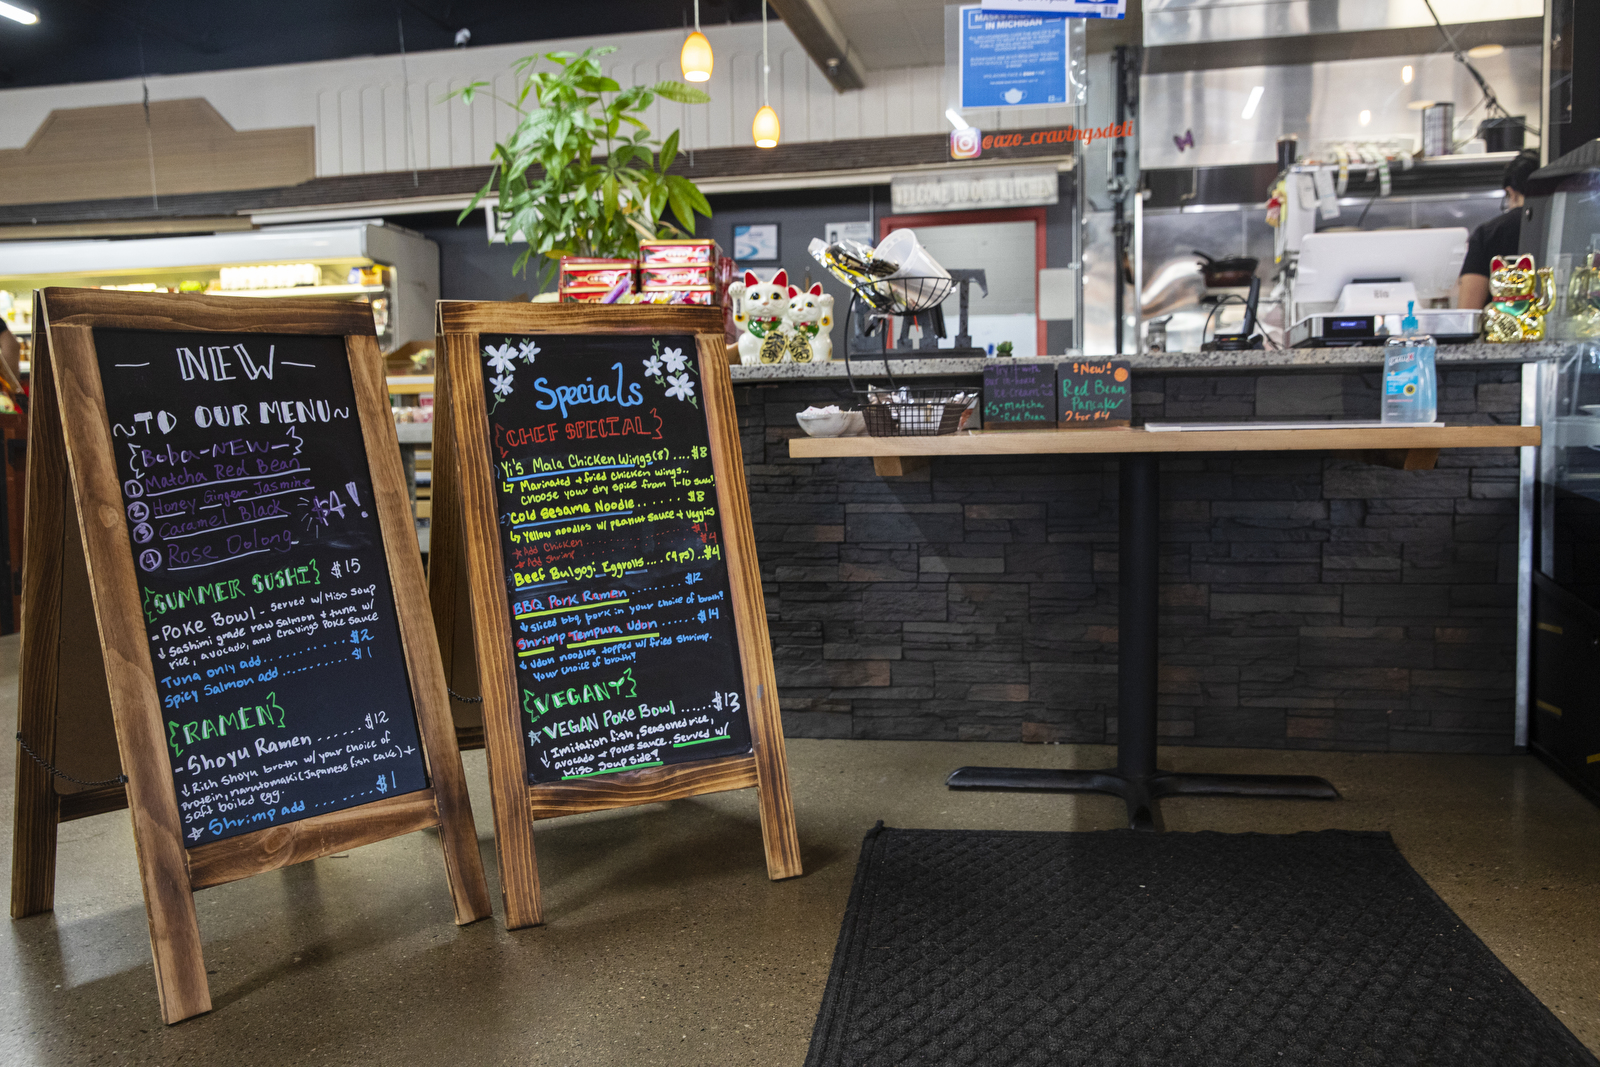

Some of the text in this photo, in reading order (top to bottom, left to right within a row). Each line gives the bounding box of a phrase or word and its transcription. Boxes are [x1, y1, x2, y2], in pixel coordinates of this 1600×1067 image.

[985, 18, 1042, 30] IN MICHIGAN
[176, 344, 274, 381] NEW
[534, 362, 644, 418] Specials
[1063, 378, 1127, 398] Red Bean
[194, 404, 250, 428] OUR
[1004, 411, 1046, 422] Red Bean
[1065, 410, 1073, 422] 2
[1075, 412, 1092, 422] for
[1072, 396, 1124, 414] Pancake
[146, 458, 300, 493] Matcha Red Bean
[501, 458, 524, 478] Yi's
[532, 457, 564, 473] Mala
[568, 454, 616, 468] Chicken
[691, 446, 708, 460] $8
[153, 476, 310, 515] Honey Ginger Jasmine
[520, 476, 571, 492] Marinated
[584, 472, 607, 482] fried
[564, 488, 588, 500] your
[592, 484, 609, 494] dry
[612, 479, 638, 493] spice
[641, 479, 666, 490] from
[674, 478, 692, 488] 1-10
[159, 498, 292, 538] Caramel Black
[510, 508, 536, 524] Cold
[540, 502, 591, 520] Sesame
[595, 499, 634, 512] Noodle
[688, 490, 705, 502] $8
[522, 530, 552, 544] Yellow
[555, 523, 592, 536] noodles
[610, 515, 646, 531] peanut
[167, 528, 292, 567] Rose Oolong
[524, 545, 538, 556] Add
[544, 539, 583, 552] Chicken
[528, 556, 542, 568] Add
[331, 558, 360, 578] $15
[514, 568, 546, 586] Beef
[549, 561, 596, 580] Bulgogi
[602, 558, 644, 578] Eggrolls
[704, 544, 720, 560] $4
[211, 584, 376, 626] Bowl served Miso soup
[513, 572, 703, 615] BBQ Pork Ramen $12
[216, 627, 246, 646] grade
[251, 620, 274, 633] raw
[330, 605, 357, 617] tuna
[530, 618, 557, 632] sliced
[561, 615, 582, 626] bbq
[585, 609, 611, 625] pork
[629, 604, 654, 615] your
[686, 592, 695, 604] of
[252, 634, 272, 646] and
[276, 622, 318, 636] Cravings
[516, 607, 720, 650] Shrimp Tempura Udon $14
[161, 628, 374, 688] Tuna only add $2
[560, 648, 596, 662] noodles
[602, 642, 632, 654] topped
[650, 637, 672, 648] fried
[592, 656, 600, 668] of
[165, 646, 372, 708] Spicy Salmon add $1
[542, 690, 740, 739] VEGAN Poke Bowl $13
[188, 711, 390, 776] Shoyu Ramen $12
[550, 737, 608, 758] Imitation
[192, 780, 218, 794] Rich
[263, 760, 298, 773] broth
[319, 748, 342, 764] your
[346, 740, 377, 753] choice
[381, 730, 390, 744] of
[350, 756, 370, 768] fish
[555, 753, 594, 770] avocado
[563, 766, 593, 776] Miso
[598, 758, 628, 771] soup
[185, 805, 214, 824] soft
[218, 795, 254, 812] boiled
[208, 770, 396, 835] Shrimp add $1
